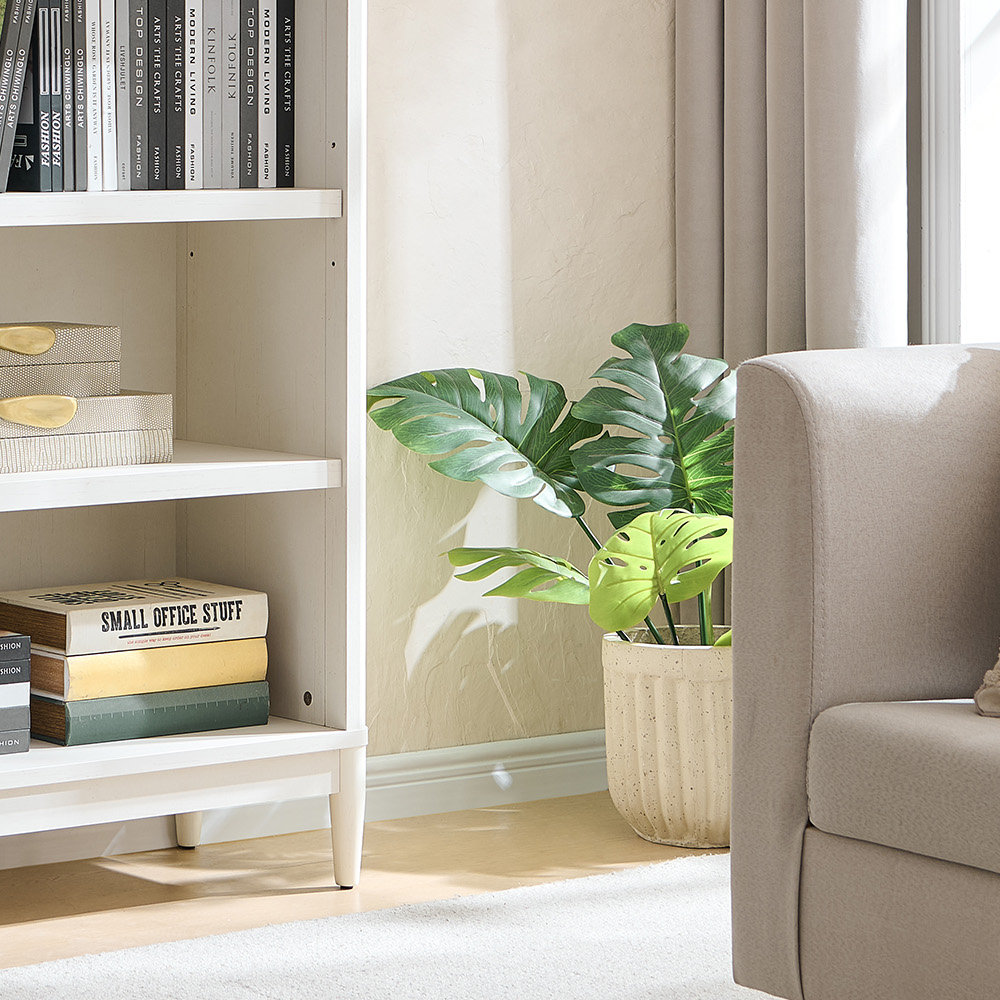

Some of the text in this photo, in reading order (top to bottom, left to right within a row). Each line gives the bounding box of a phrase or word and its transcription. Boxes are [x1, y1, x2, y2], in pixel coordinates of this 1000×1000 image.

[174, 15, 182, 44] ARTS
[247, 7, 255, 38] TOP
[0, 49, 14, 102] CHIWINGLO
[174, 46, 182, 68] THE
[207, 27, 216, 94] KINFOLK
[228, 33, 236, 99] KINFOLK
[6, 103, 17, 128] ARTS
[12, 49, 26, 101] CHIWINGLO
[174, 70, 182, 112] CRAFTS
[40, 110, 50, 167] FASHION
[52, 110, 61, 167] FASHION
[101, 600, 243, 633] SMALL OFFICE STUFF
